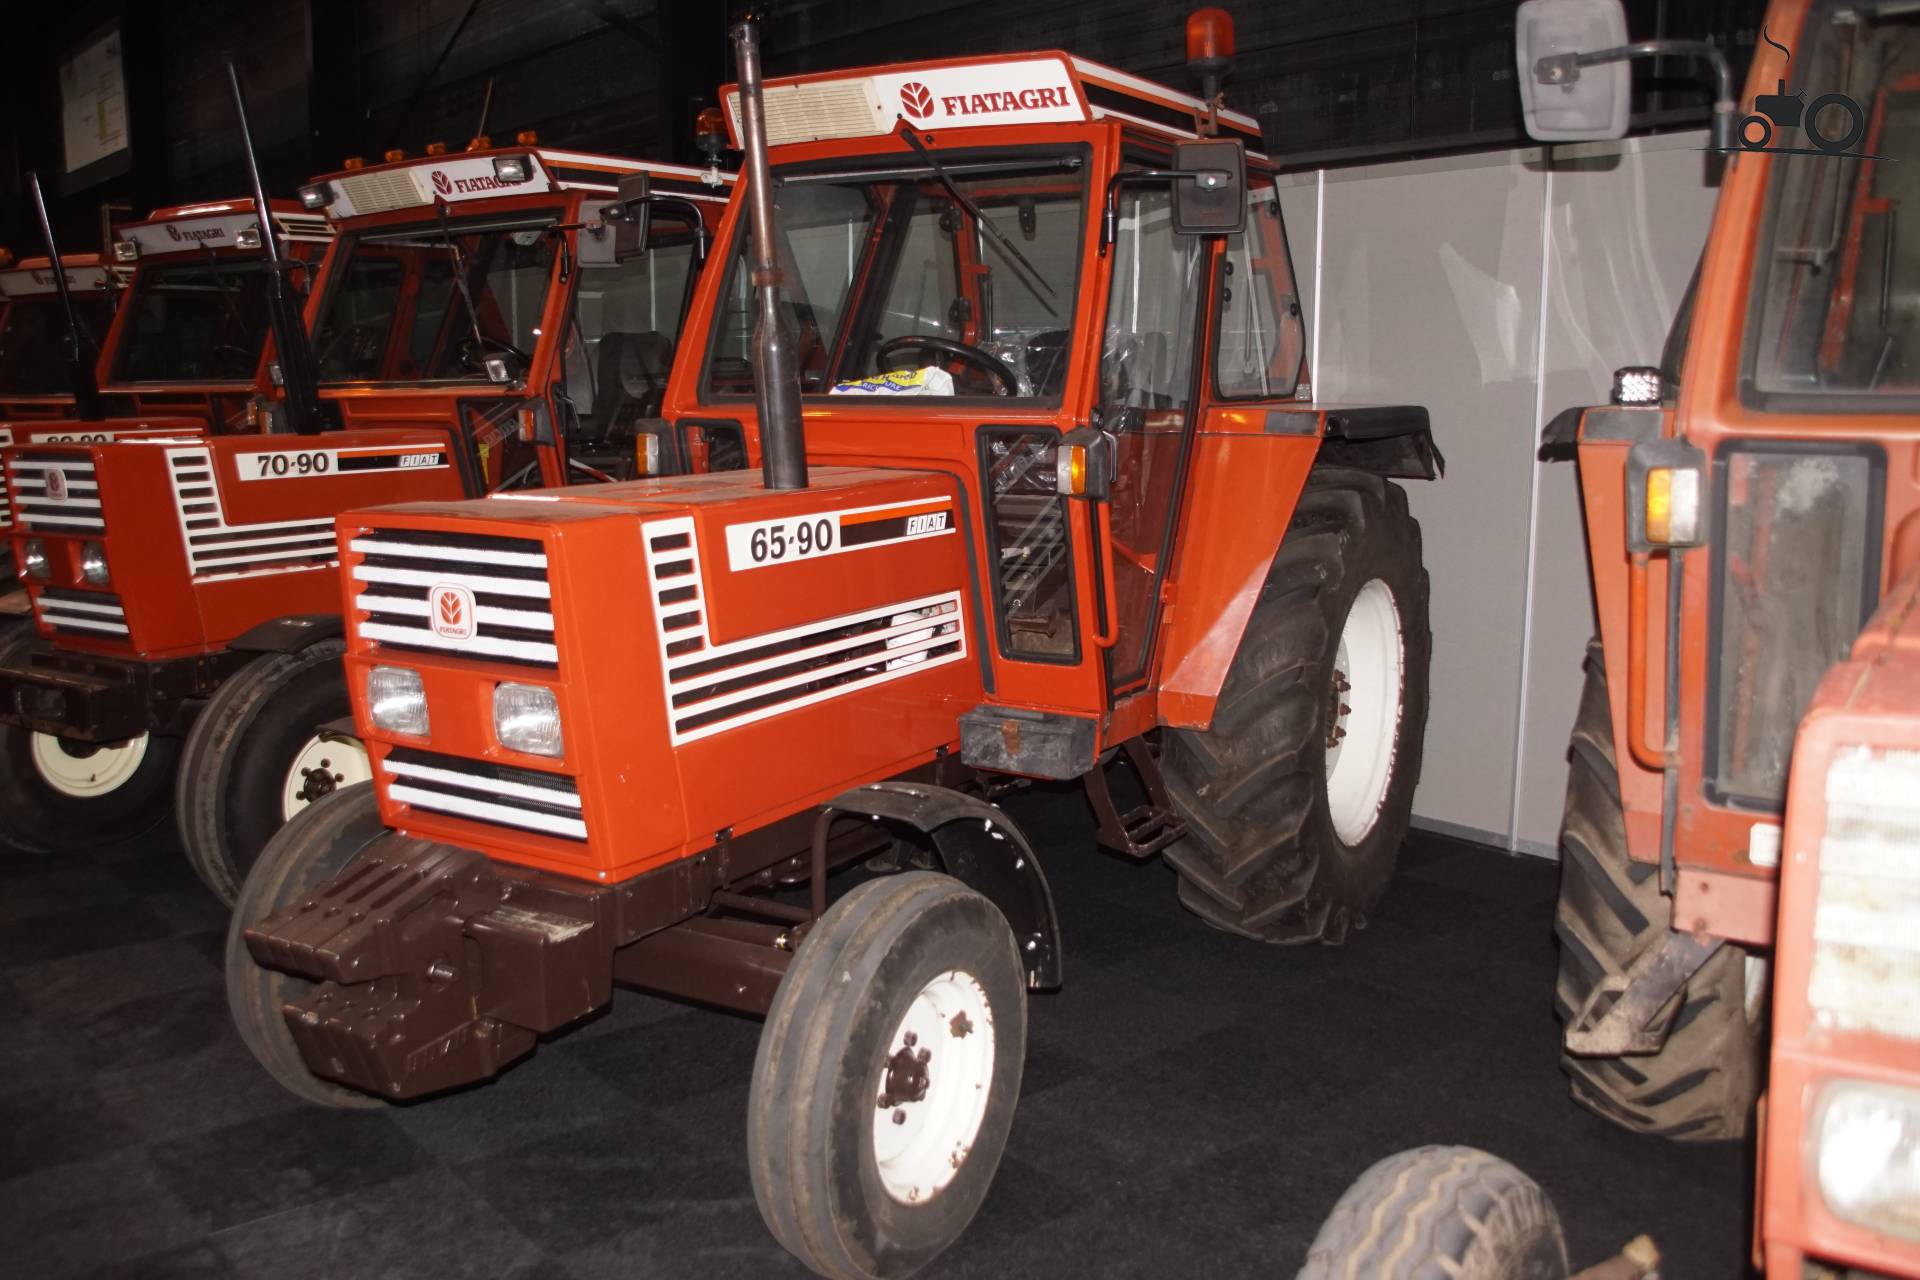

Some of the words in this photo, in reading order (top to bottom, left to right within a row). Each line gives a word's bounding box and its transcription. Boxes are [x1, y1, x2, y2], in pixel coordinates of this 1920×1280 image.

[941, 86, 1070, 117] FIATAGRI
[454, 174, 521, 193] FIATA
[257, 452, 330, 476] 70-90
[401, 455, 438, 467] FIAT
[750, 518, 834, 562] 65-90
[908, 513, 946, 534] FIAT
